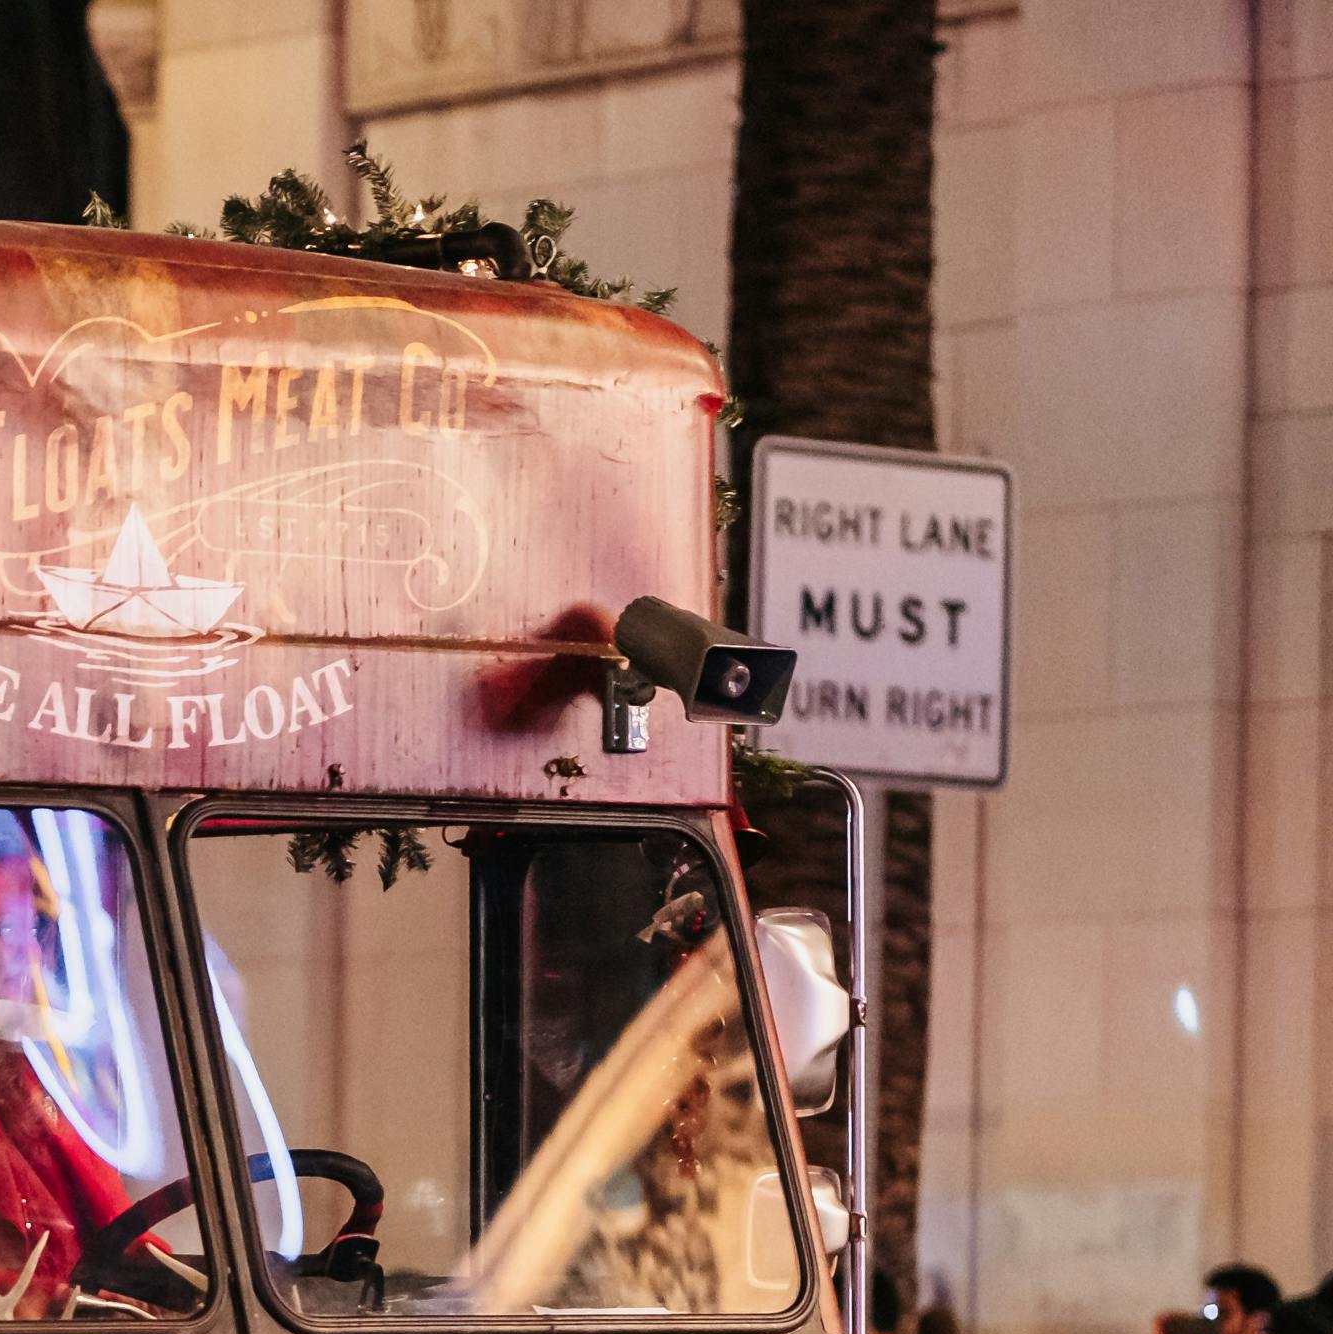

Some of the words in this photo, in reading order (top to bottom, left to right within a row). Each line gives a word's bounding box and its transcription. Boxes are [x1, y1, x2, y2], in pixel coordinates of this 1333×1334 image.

[217, 350, 375, 465] MEAT
[773, 496, 883, 545] RIGHT
[898, 508, 995, 560] LANE
[798, 584, 968, 649] MUST
[28, 681, 153, 750] ALL
[167, 659, 354, 750] FLOAT
[789, 678, 872, 722] URN
[885, 685, 994, 732] RIGHT
